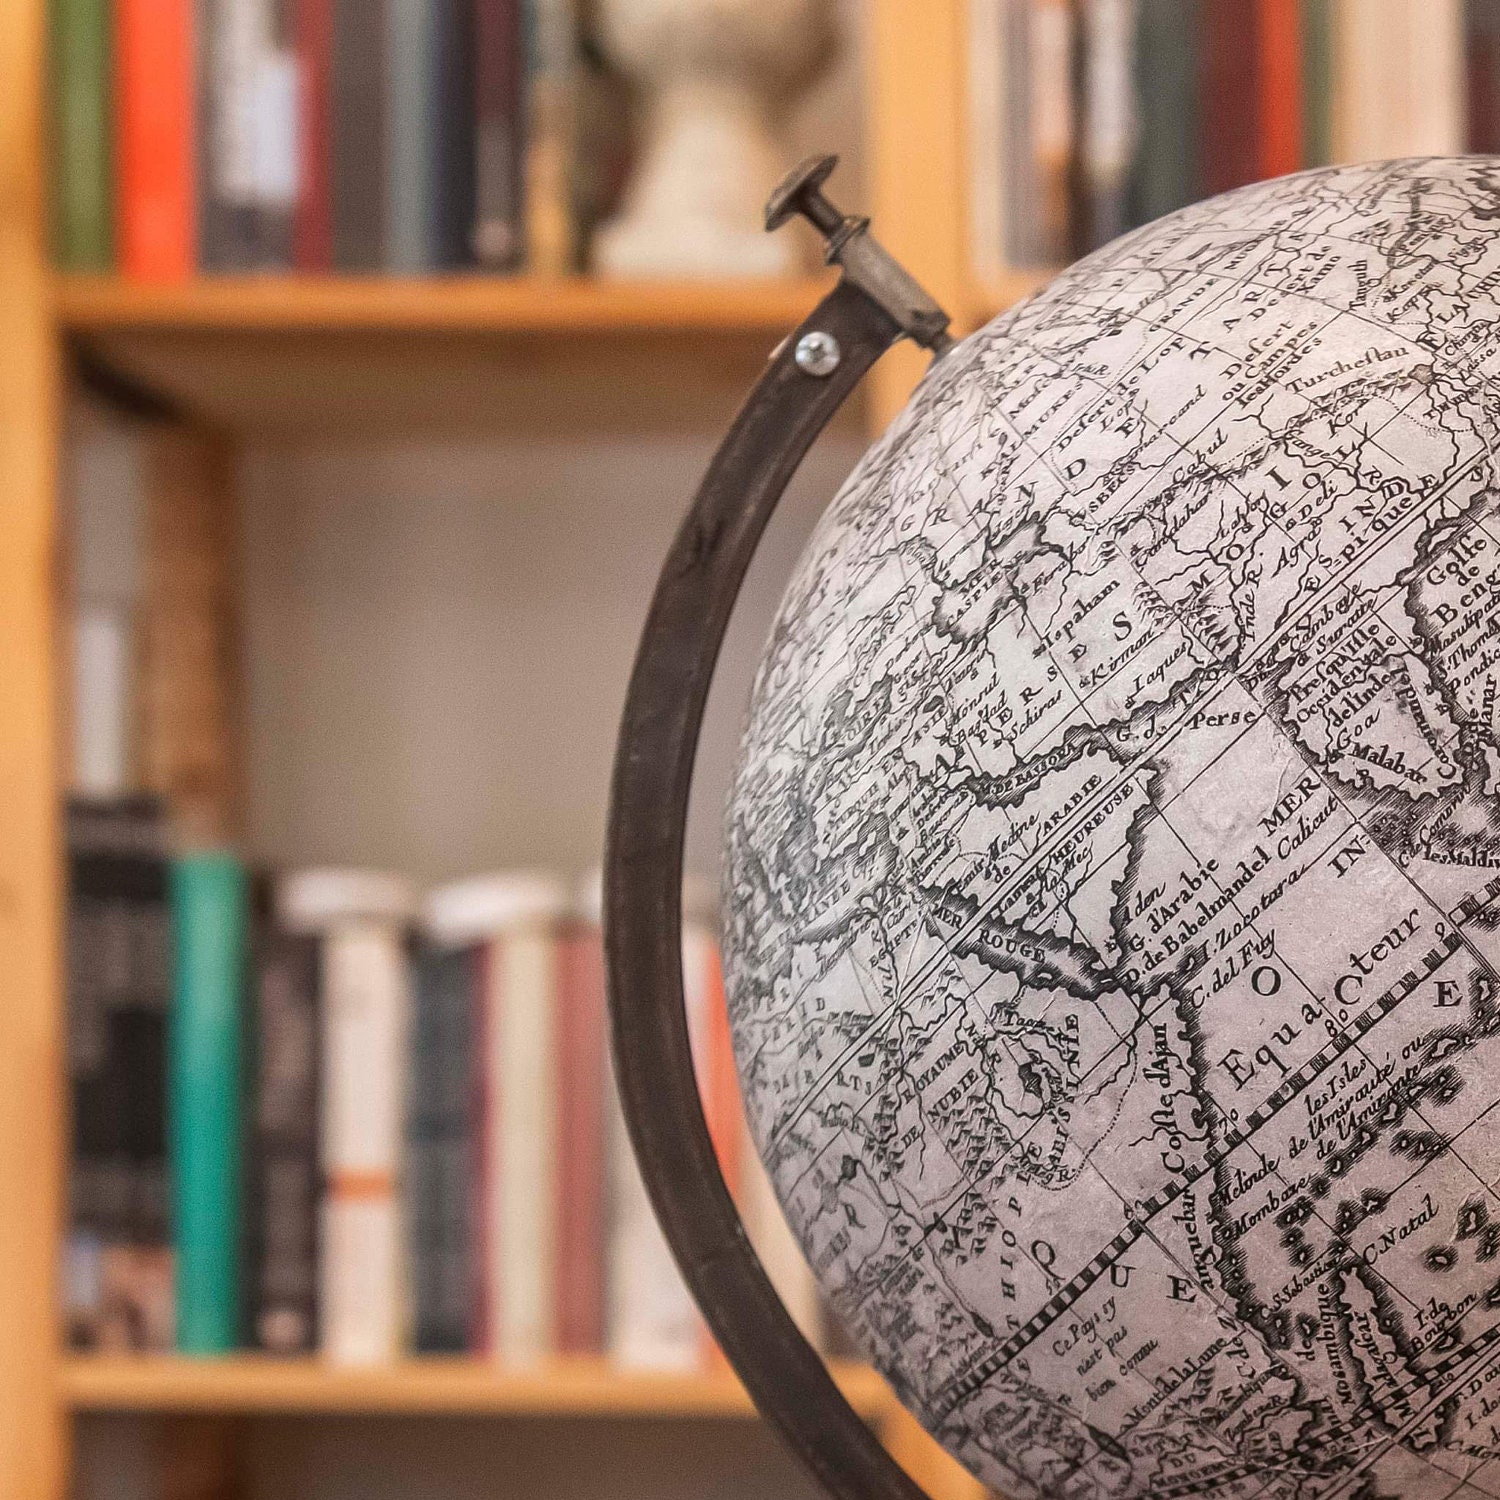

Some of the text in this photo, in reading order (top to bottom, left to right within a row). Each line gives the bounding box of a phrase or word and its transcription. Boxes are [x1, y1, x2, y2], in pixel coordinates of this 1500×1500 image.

[1222, 321, 1318, 402] ou Campes
[1458, 564, 1480, 587] de
[1338, 709, 1380, 749] Goa
[1349, 741, 1427, 783] Malabar
[1042, 774, 1103, 836] ARABIE
[1051, 784, 1135, 865] HEUREUSE
[1257, 776, 1321, 836] MER
[978, 929, 1046, 964] ROUGE
[927, 1068, 979, 1124] NUBIE
